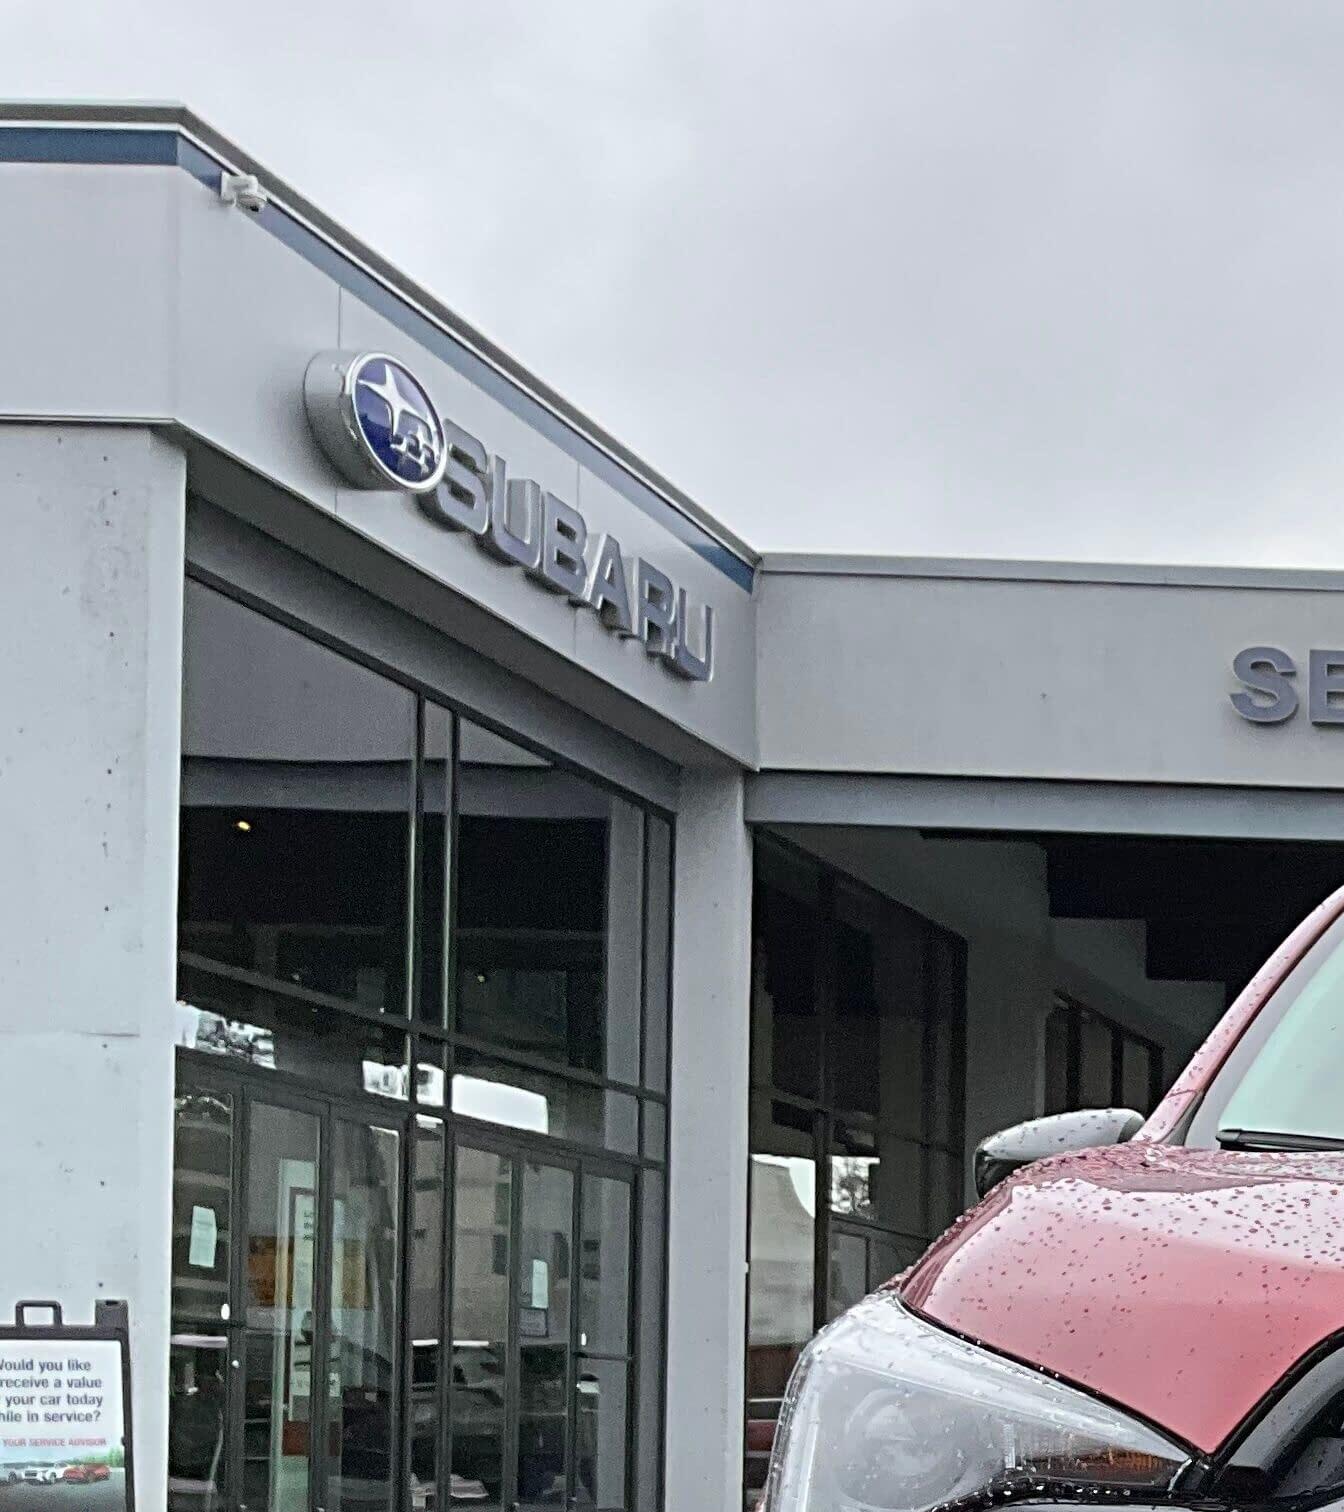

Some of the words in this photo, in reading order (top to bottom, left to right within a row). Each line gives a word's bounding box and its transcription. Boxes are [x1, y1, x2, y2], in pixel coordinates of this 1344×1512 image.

[437, 418, 714, 682] SUBARU
[39, 1361, 63, 1374] you
[68, 1359, 91, 1371] like
[0, 1376, 49, 1388] receive
[54, 1379, 61, 1388] a
[67, 1376, 102, 1388] value
[5, 1395, 35, 1408] your
[40, 1395, 61, 1406] car
[67, 1393, 103, 1407] today
[27, 1410, 39, 1422] in
[44, 1410, 101, 1422] service?
